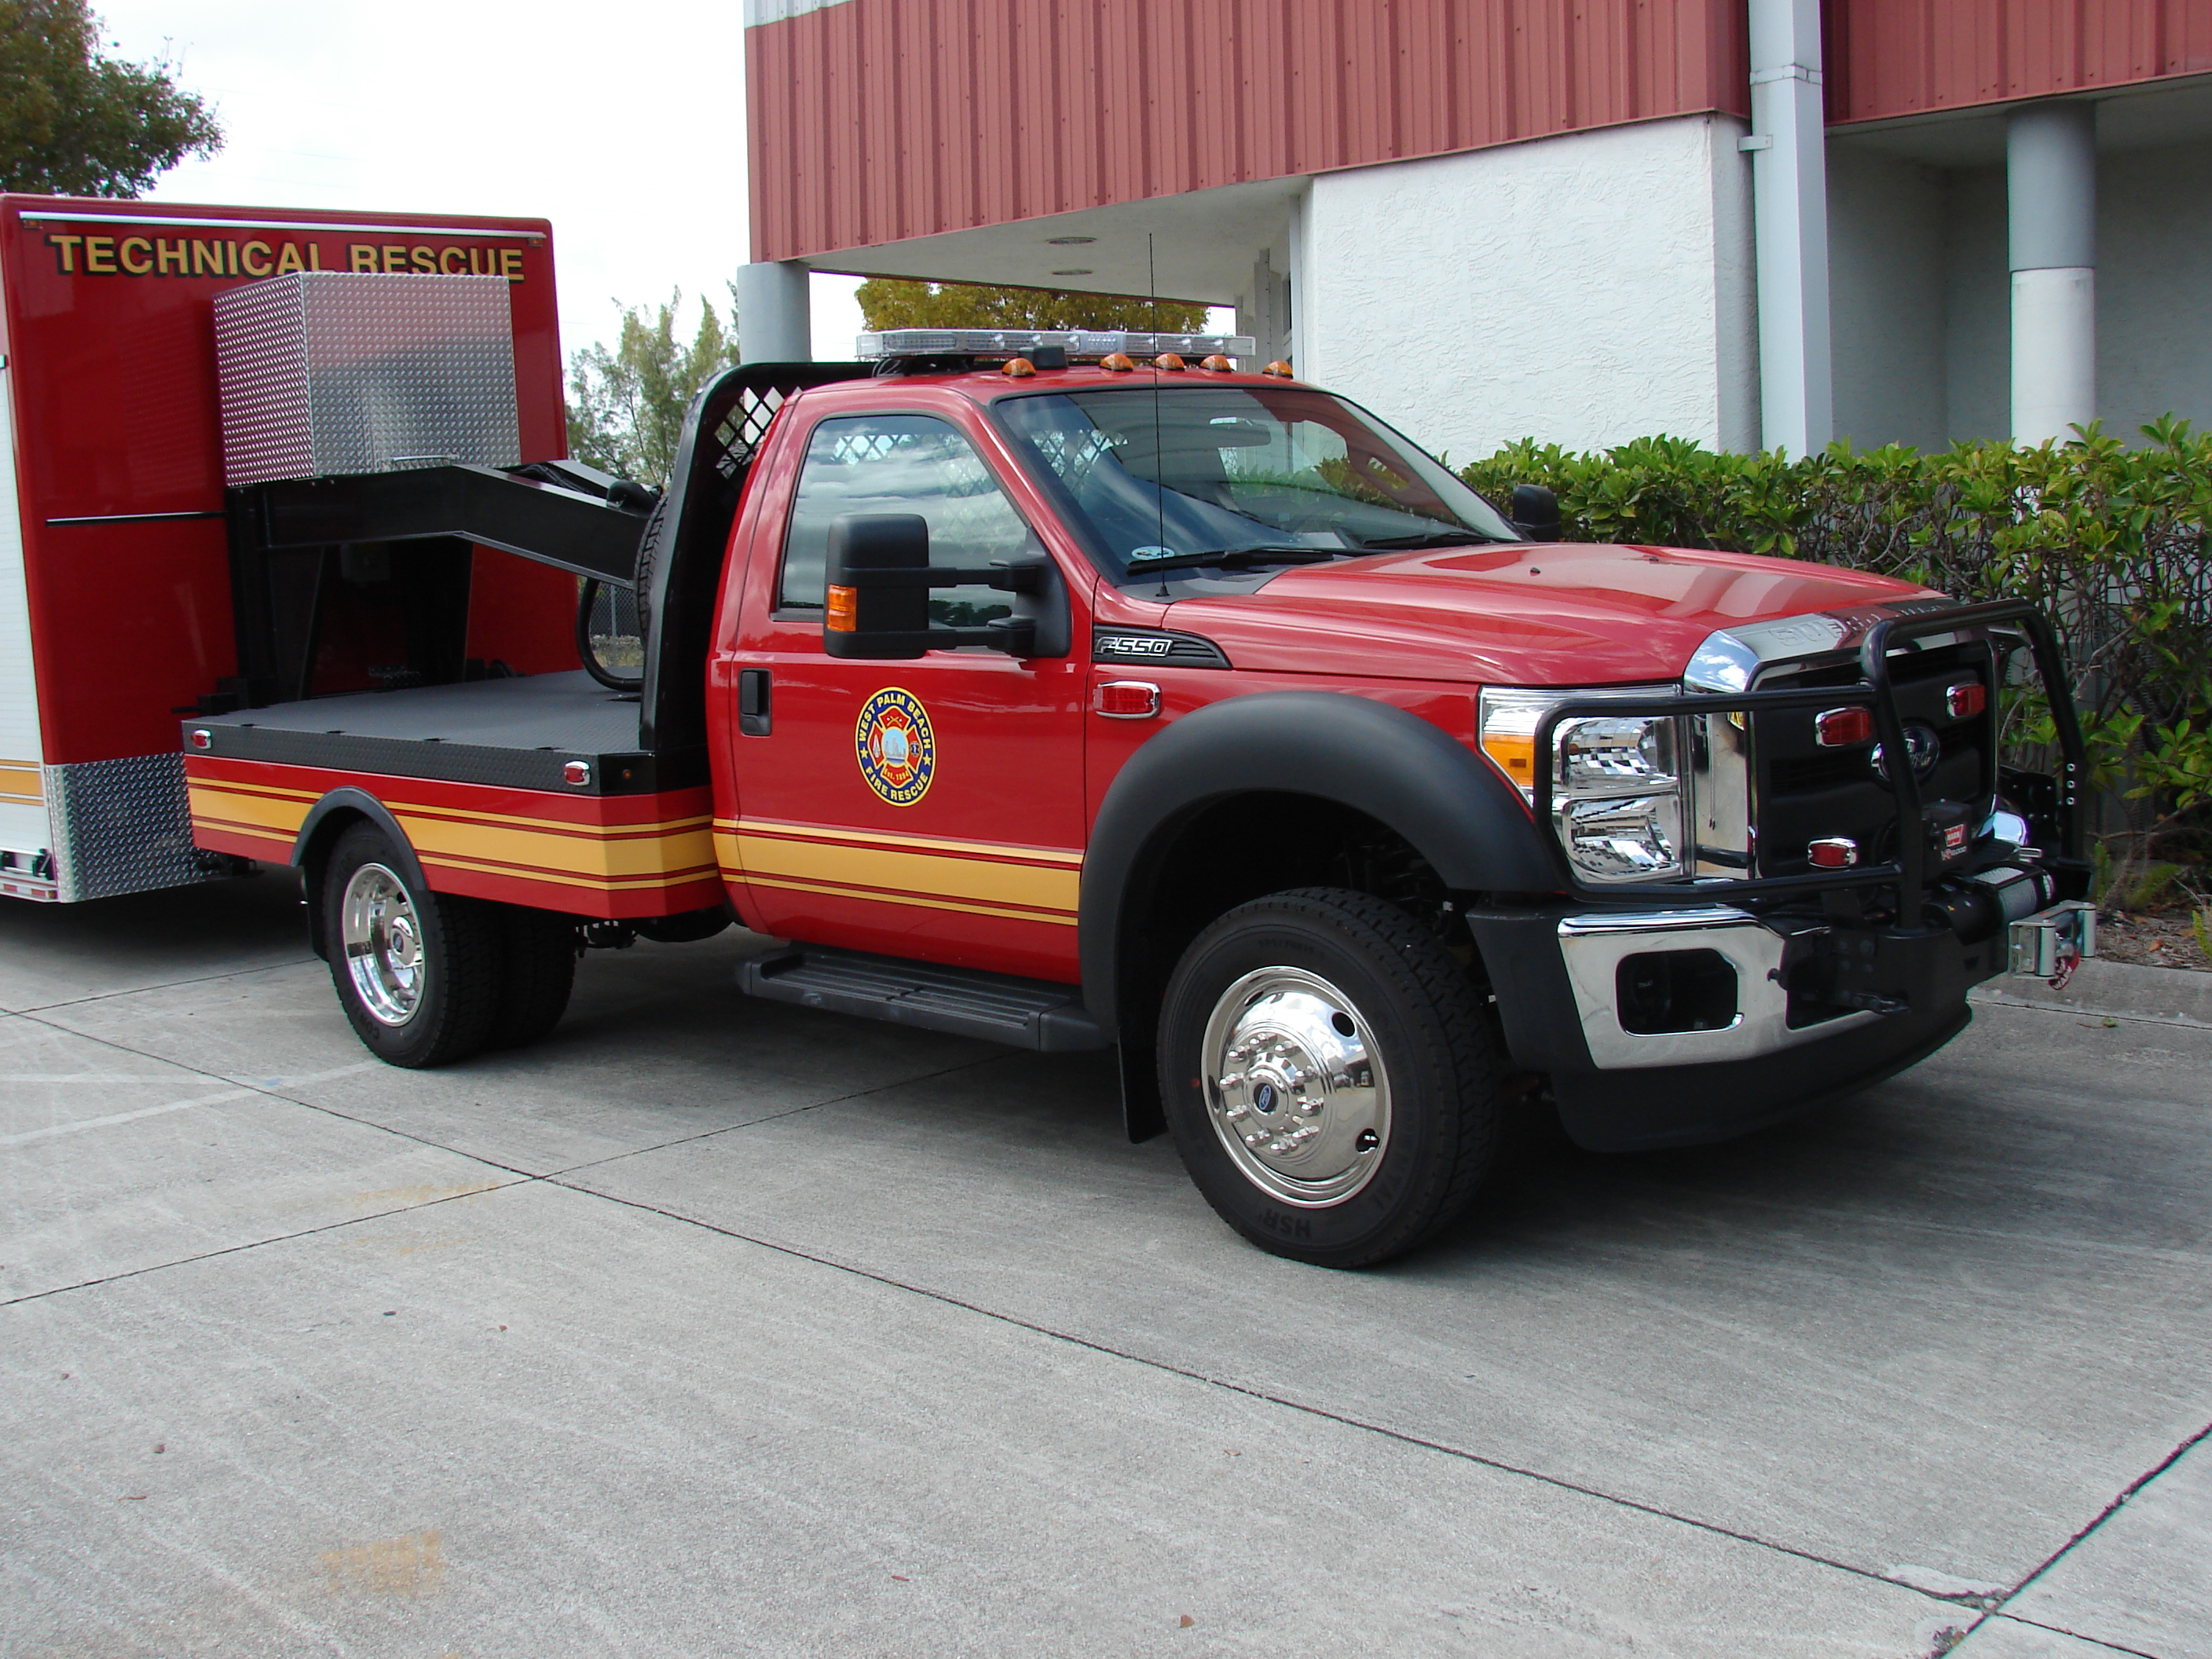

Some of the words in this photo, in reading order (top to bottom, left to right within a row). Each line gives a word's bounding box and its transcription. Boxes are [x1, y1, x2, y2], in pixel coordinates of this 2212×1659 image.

[49, 235, 335, 277] TECHNICAL
[350, 244, 526, 282] RESCUE
[859, 704, 876, 742] WEST
[876, 693, 906, 708] PALM
[907, 701, 932, 749] BEACH
[866, 766, 888, 796] FIRE
[891, 771, 928, 801] RESCUE
